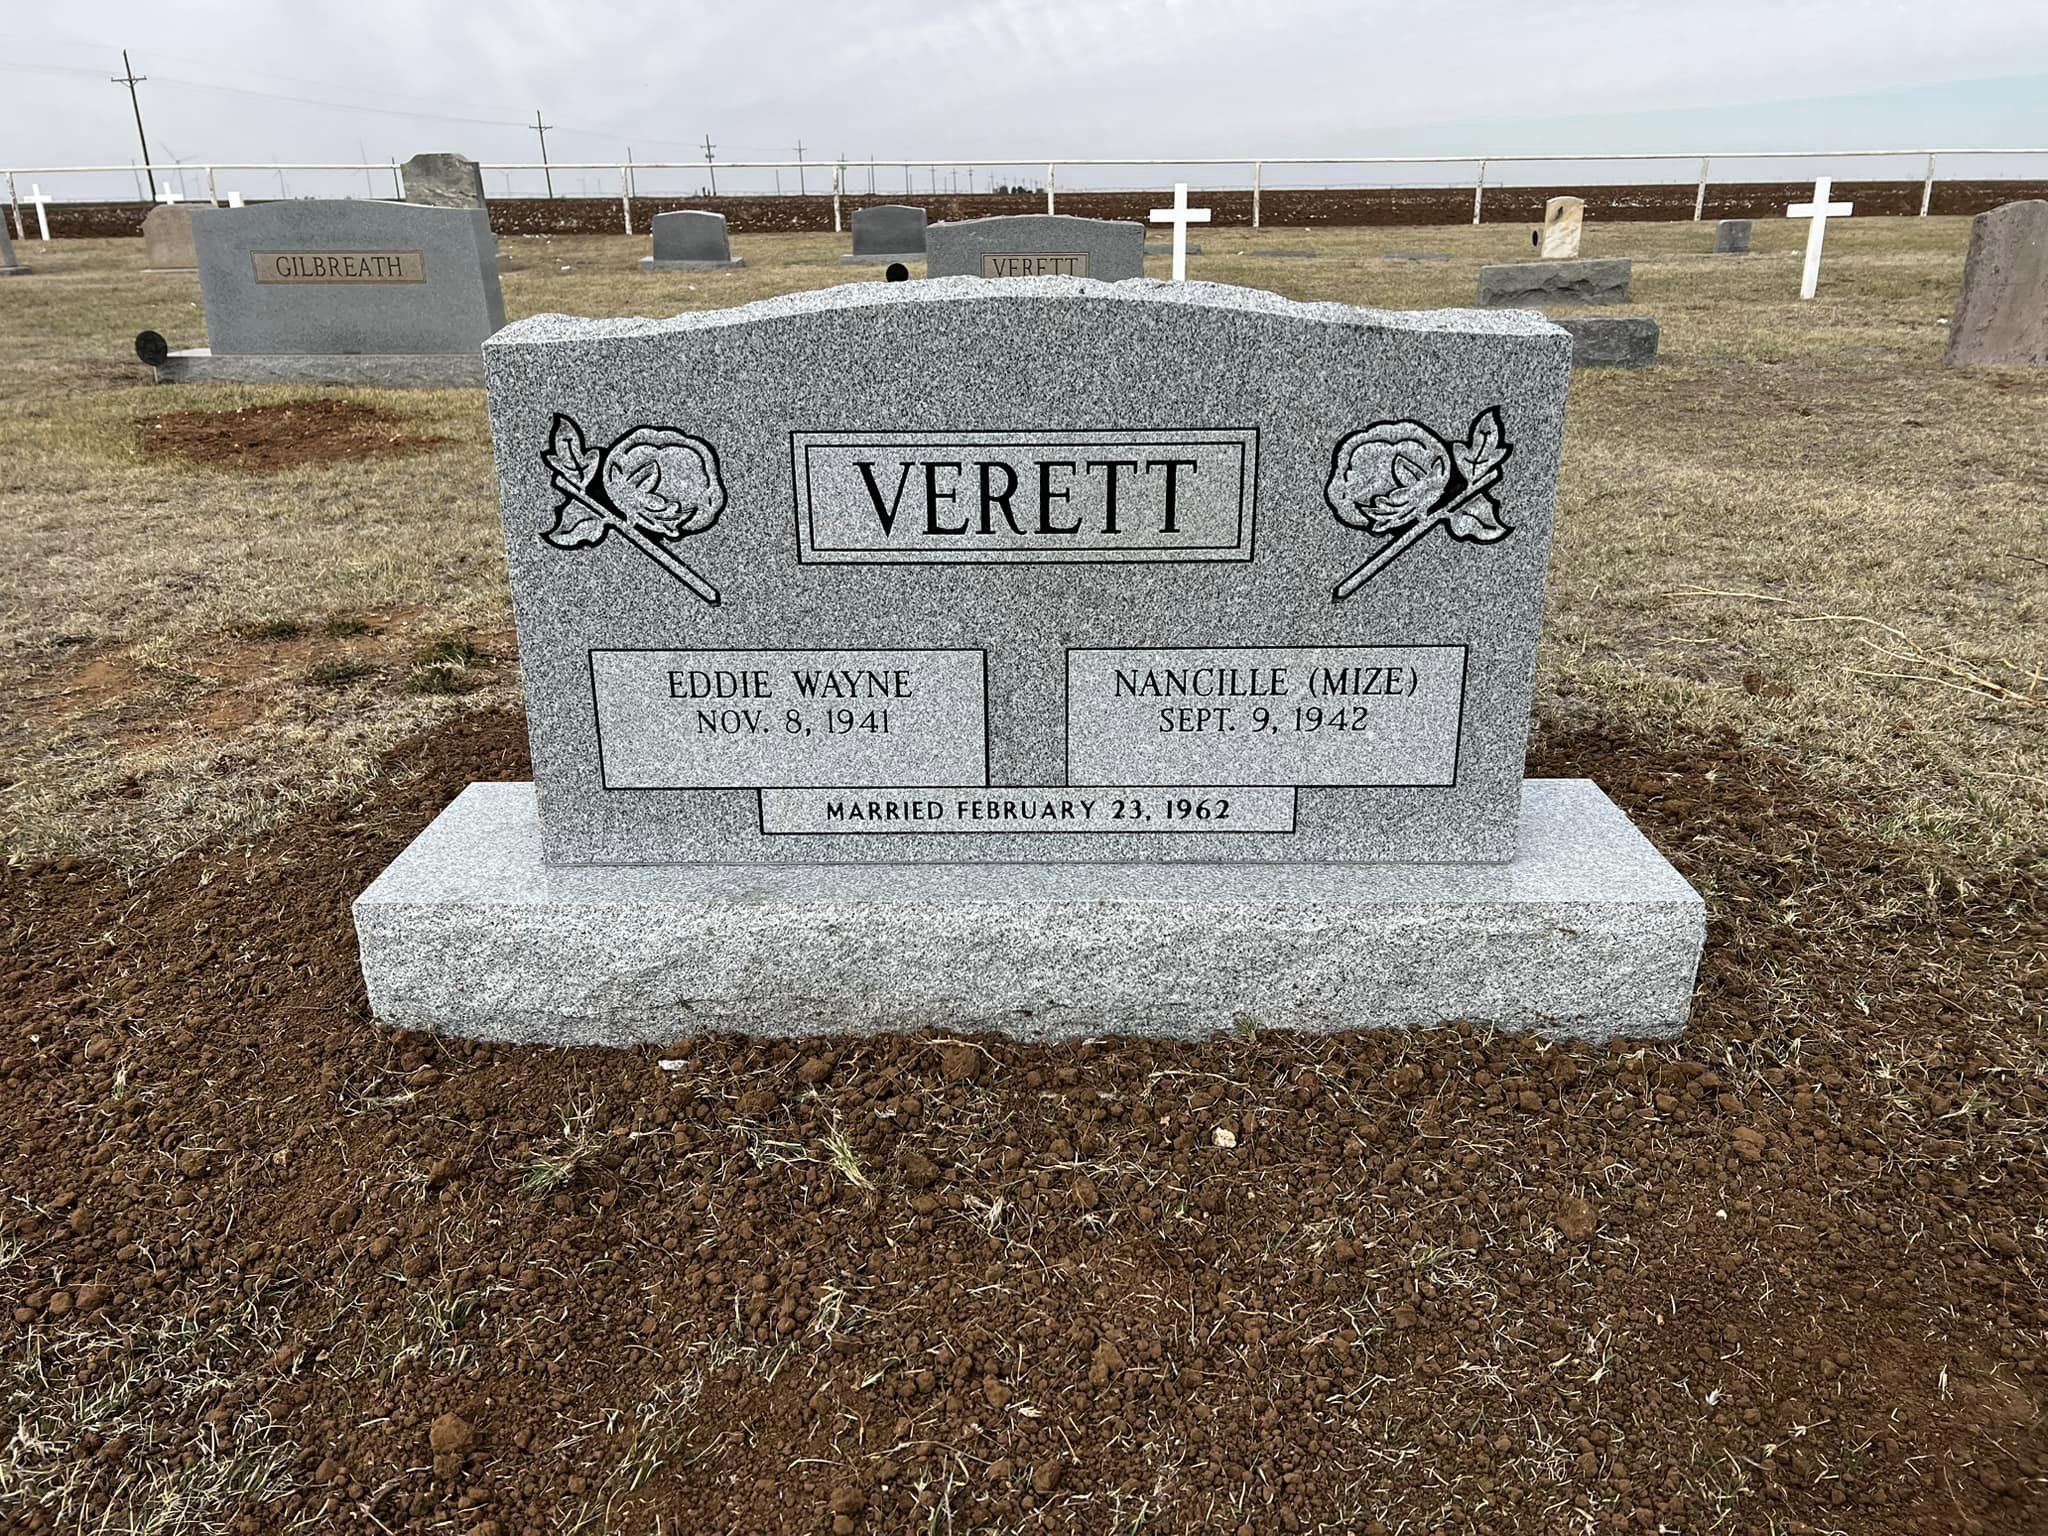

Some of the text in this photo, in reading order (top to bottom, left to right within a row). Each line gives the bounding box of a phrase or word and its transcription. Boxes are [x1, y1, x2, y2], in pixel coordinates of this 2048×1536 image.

[275, 256, 404, 278] GILBREATH
[992, 257, 1079, 277] VERETT
[852, 459, 1198, 538] VERETT
[666, 670, 913, 699] EDDIE WAYNE
[1114, 666, 1418, 698] NANCILLE (MIZE)
[696, 708, 890, 738] NOV. 8, 1941
[1158, 705, 1369, 736] SEPT. 9, 1942
[826, 798, 1231, 823] MARRIED FEBRUARY 23, 1962
